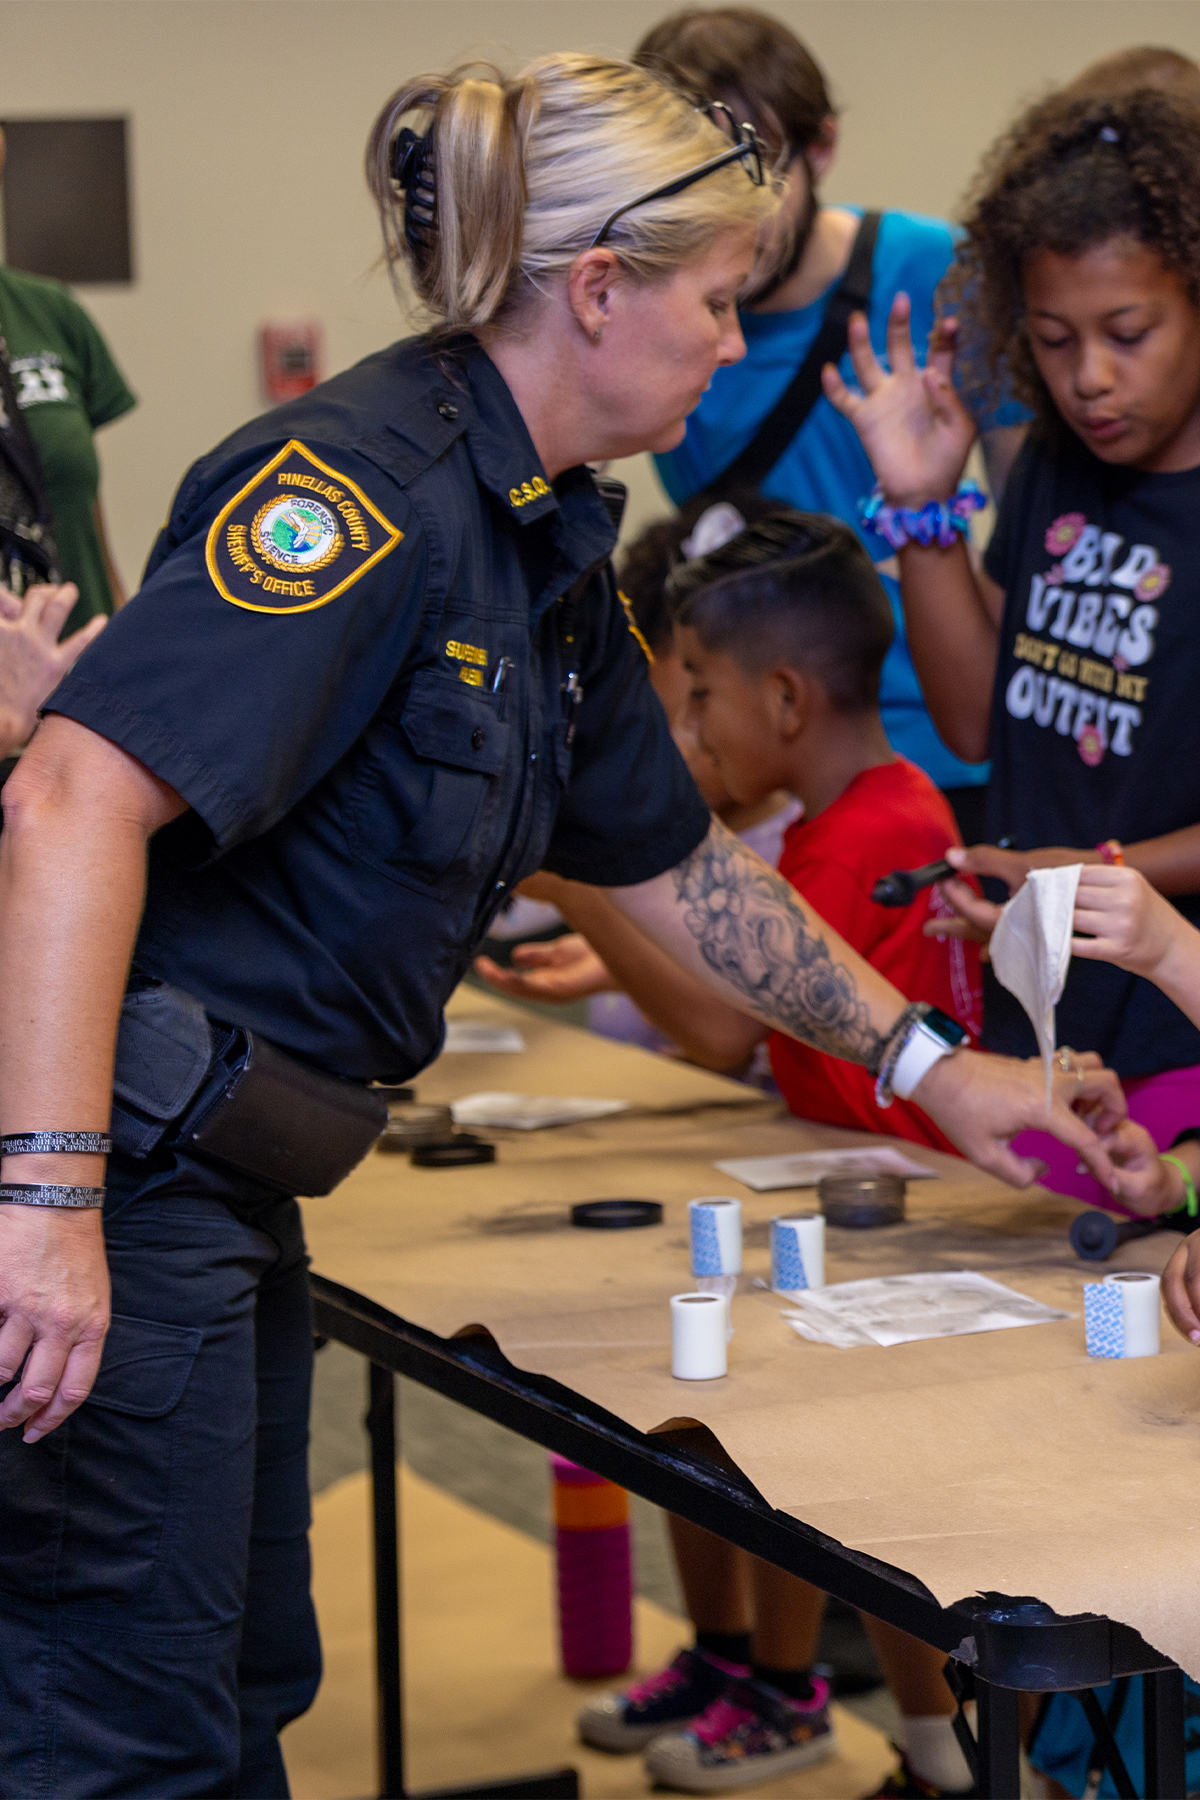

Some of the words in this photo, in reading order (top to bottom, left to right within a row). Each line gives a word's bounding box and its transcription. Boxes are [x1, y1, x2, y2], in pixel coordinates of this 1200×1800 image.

[277, 472, 347, 503] PINELLAS
[337, 500, 371, 552] COUNTY
[290, 498, 334, 536] FORENSIC
[226, 523, 267, 585] SHERIFF'S
[261, 575, 317, 597] OFFICE
[260, 530, 299, 564] SCIENCE
[1026, 573, 1160, 666] VIBES
[1006, 664, 1142, 756] OUTFIT
[6, 1144, 49, 1153] HARTWICK
[65, 1144, 98, 1152] MICHAEL
[70, 1138, 100, 1146] COUNTY
[0, 1189, 23, 1197] OFFIC
